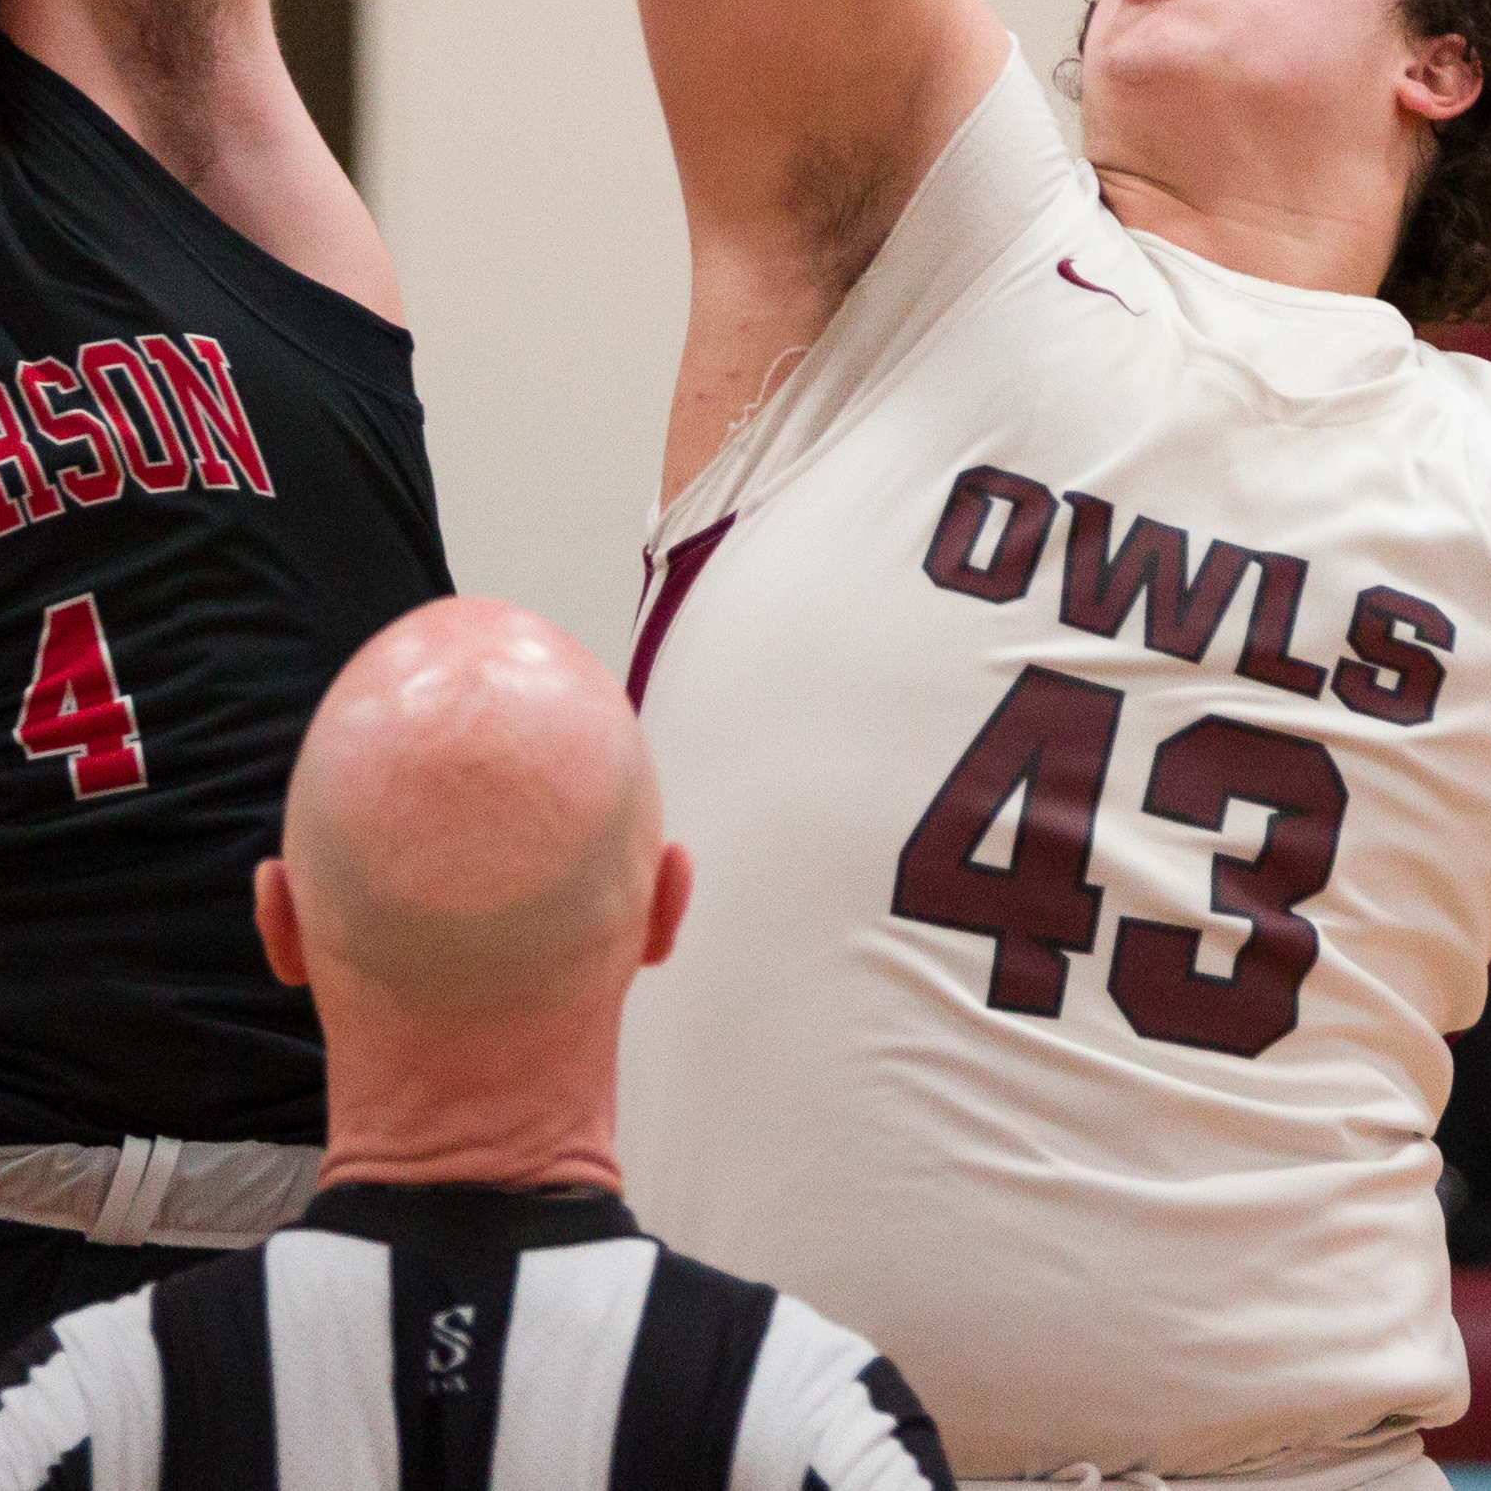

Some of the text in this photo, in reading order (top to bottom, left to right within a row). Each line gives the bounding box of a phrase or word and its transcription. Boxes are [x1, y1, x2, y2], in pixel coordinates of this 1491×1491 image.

[13, 593, 148, 801] 4
[922, 464, 1456, 727] OWLS
[890, 664, 1349, 1059] 43
